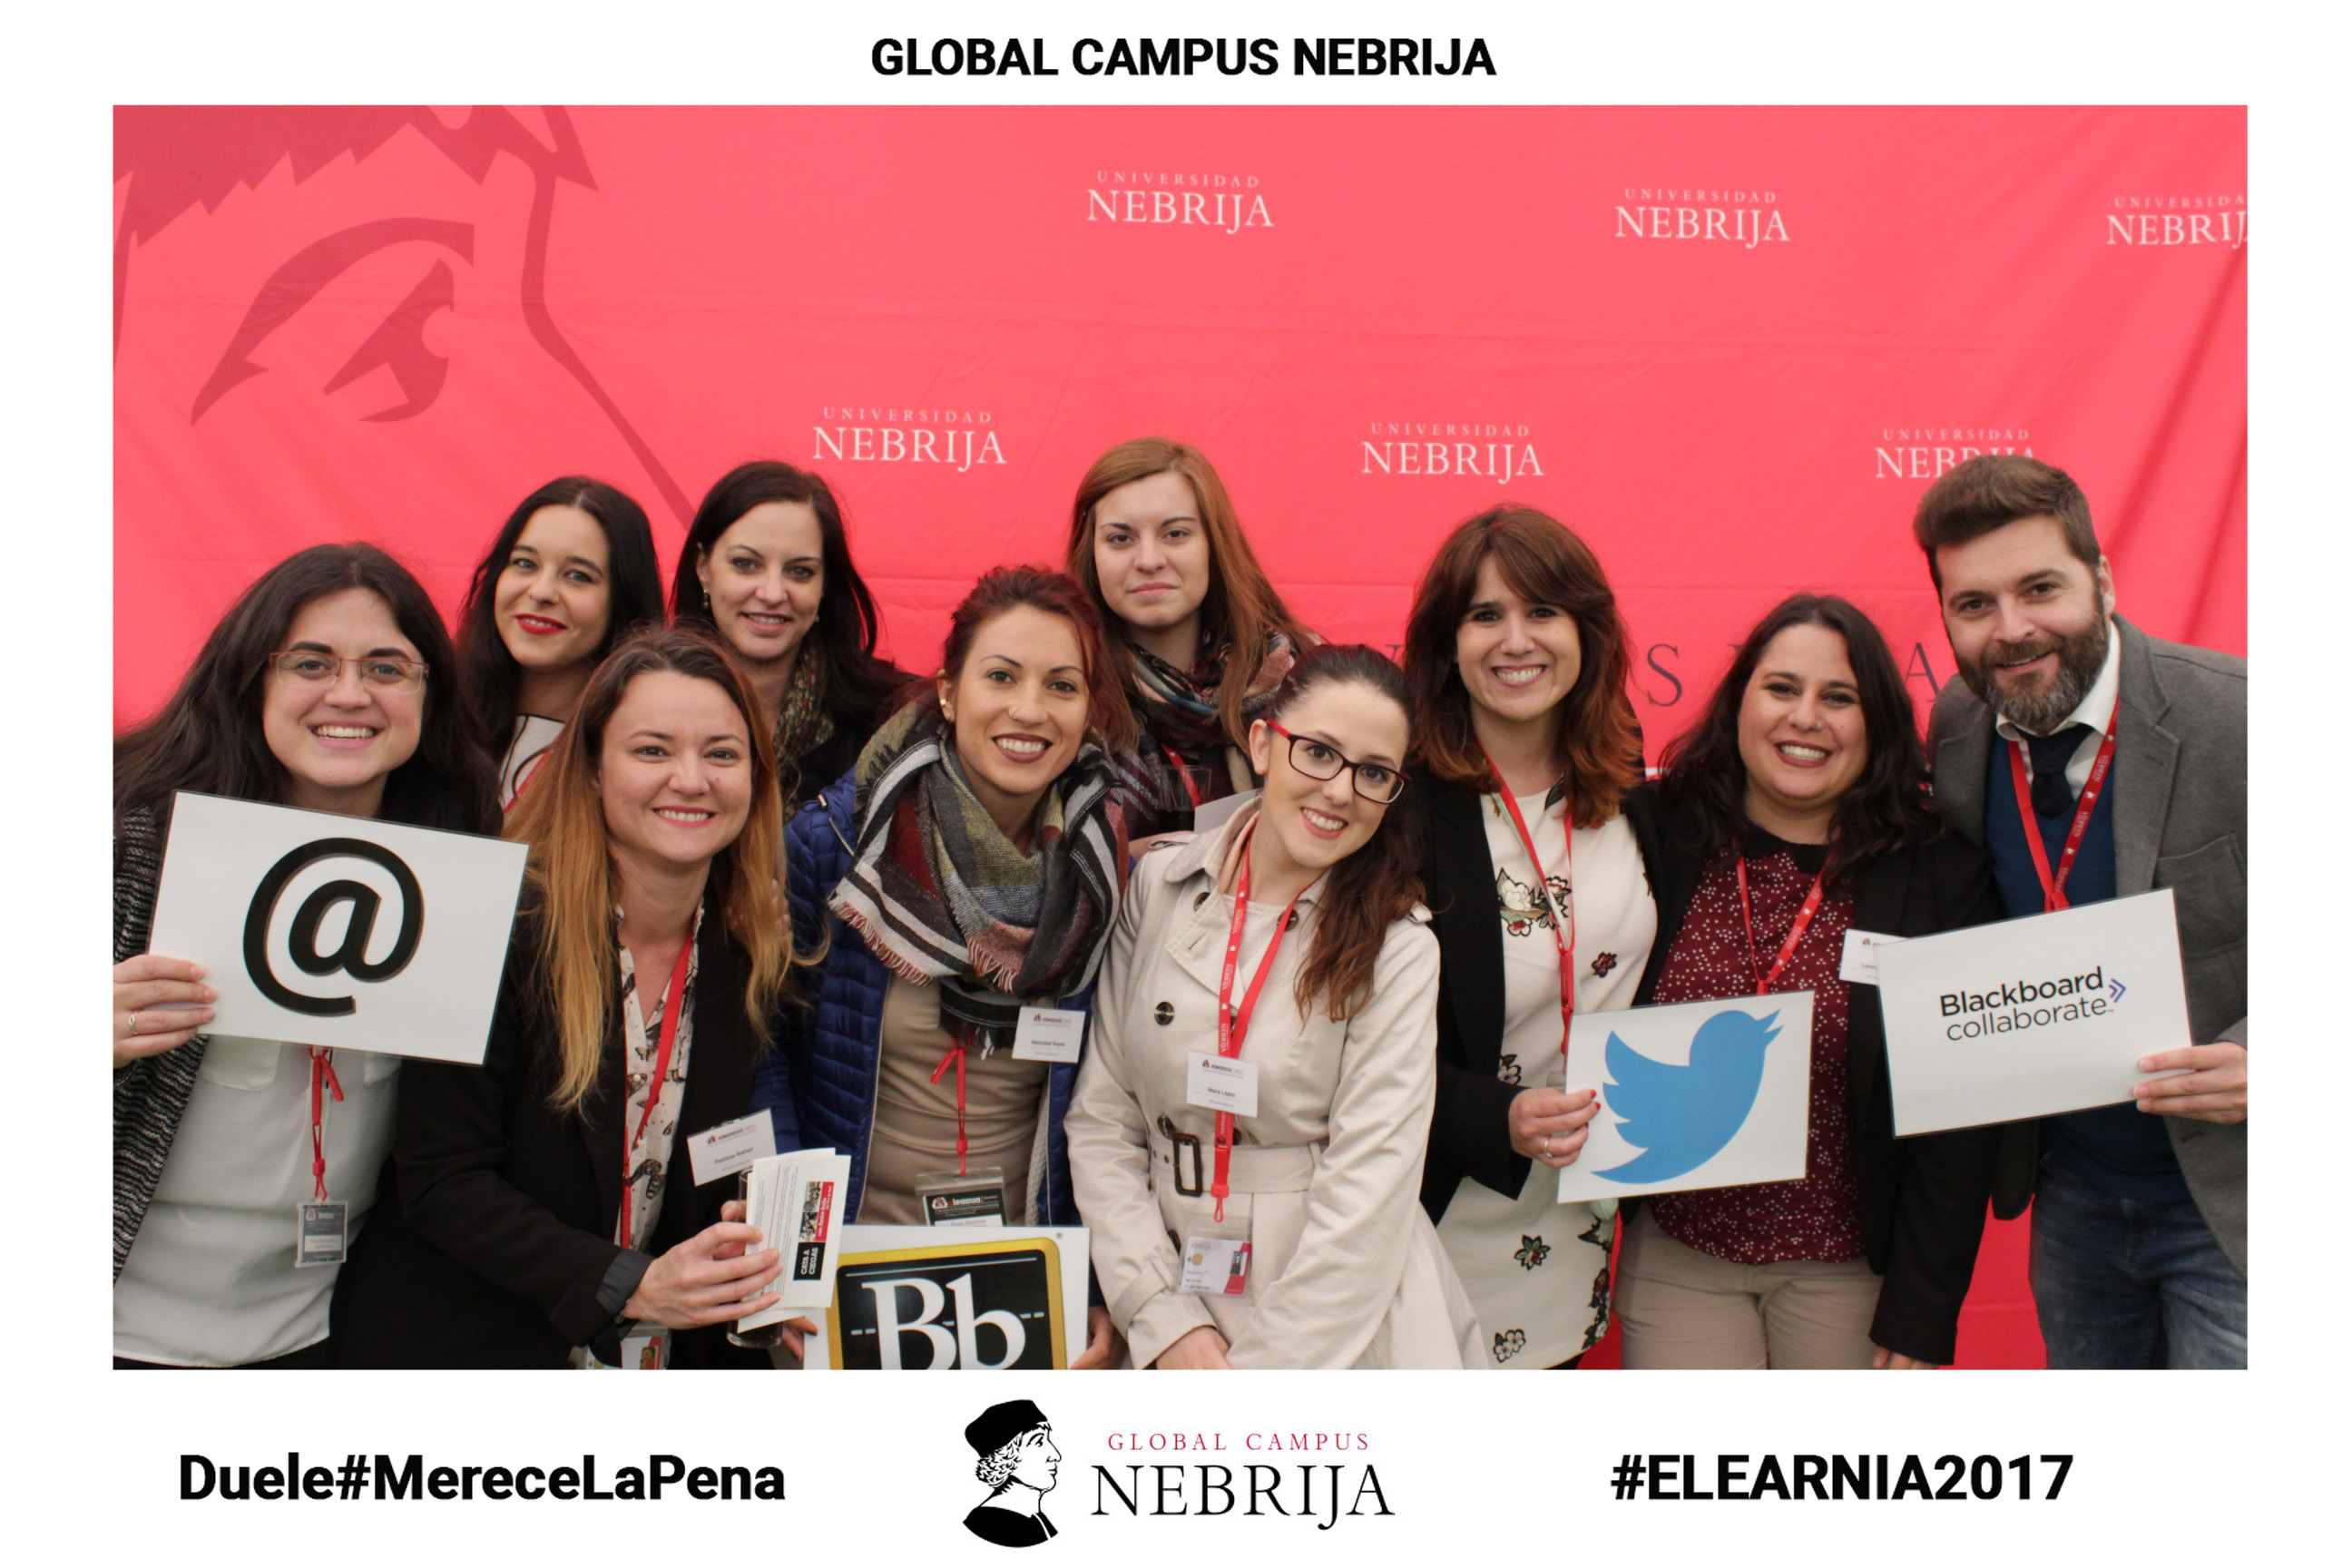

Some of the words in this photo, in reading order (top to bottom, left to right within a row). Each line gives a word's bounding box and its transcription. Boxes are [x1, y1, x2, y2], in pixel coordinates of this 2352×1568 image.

[1096, 170, 1259, 188] UNIVERSIDAD
[1624, 188, 1777, 203] UNIVERSIDAD
[1086, 189, 1275, 235] NEBRIJA
[2113, 193, 2247, 209] UNIVERSIDA
[1615, 206, 1791, 250] NEBRIJA
[2105, 211, 2248, 250] NEBRIJ
[823, 407, 992, 424] UNIVERSIDAD
[1370, 422, 1530, 436] UNIVERSIDAD
[1883, 428, 2030, 441] UNIVERSIDAD
[812, 426, 1007, 473] NEBRIJA
[1361, 442, 1545, 485] NEBRIJA
[243, 838, 425, 1017] @
[1939, 965, 2103, 1017] Blackboard
[1946, 997, 2107, 1041] collaborate
